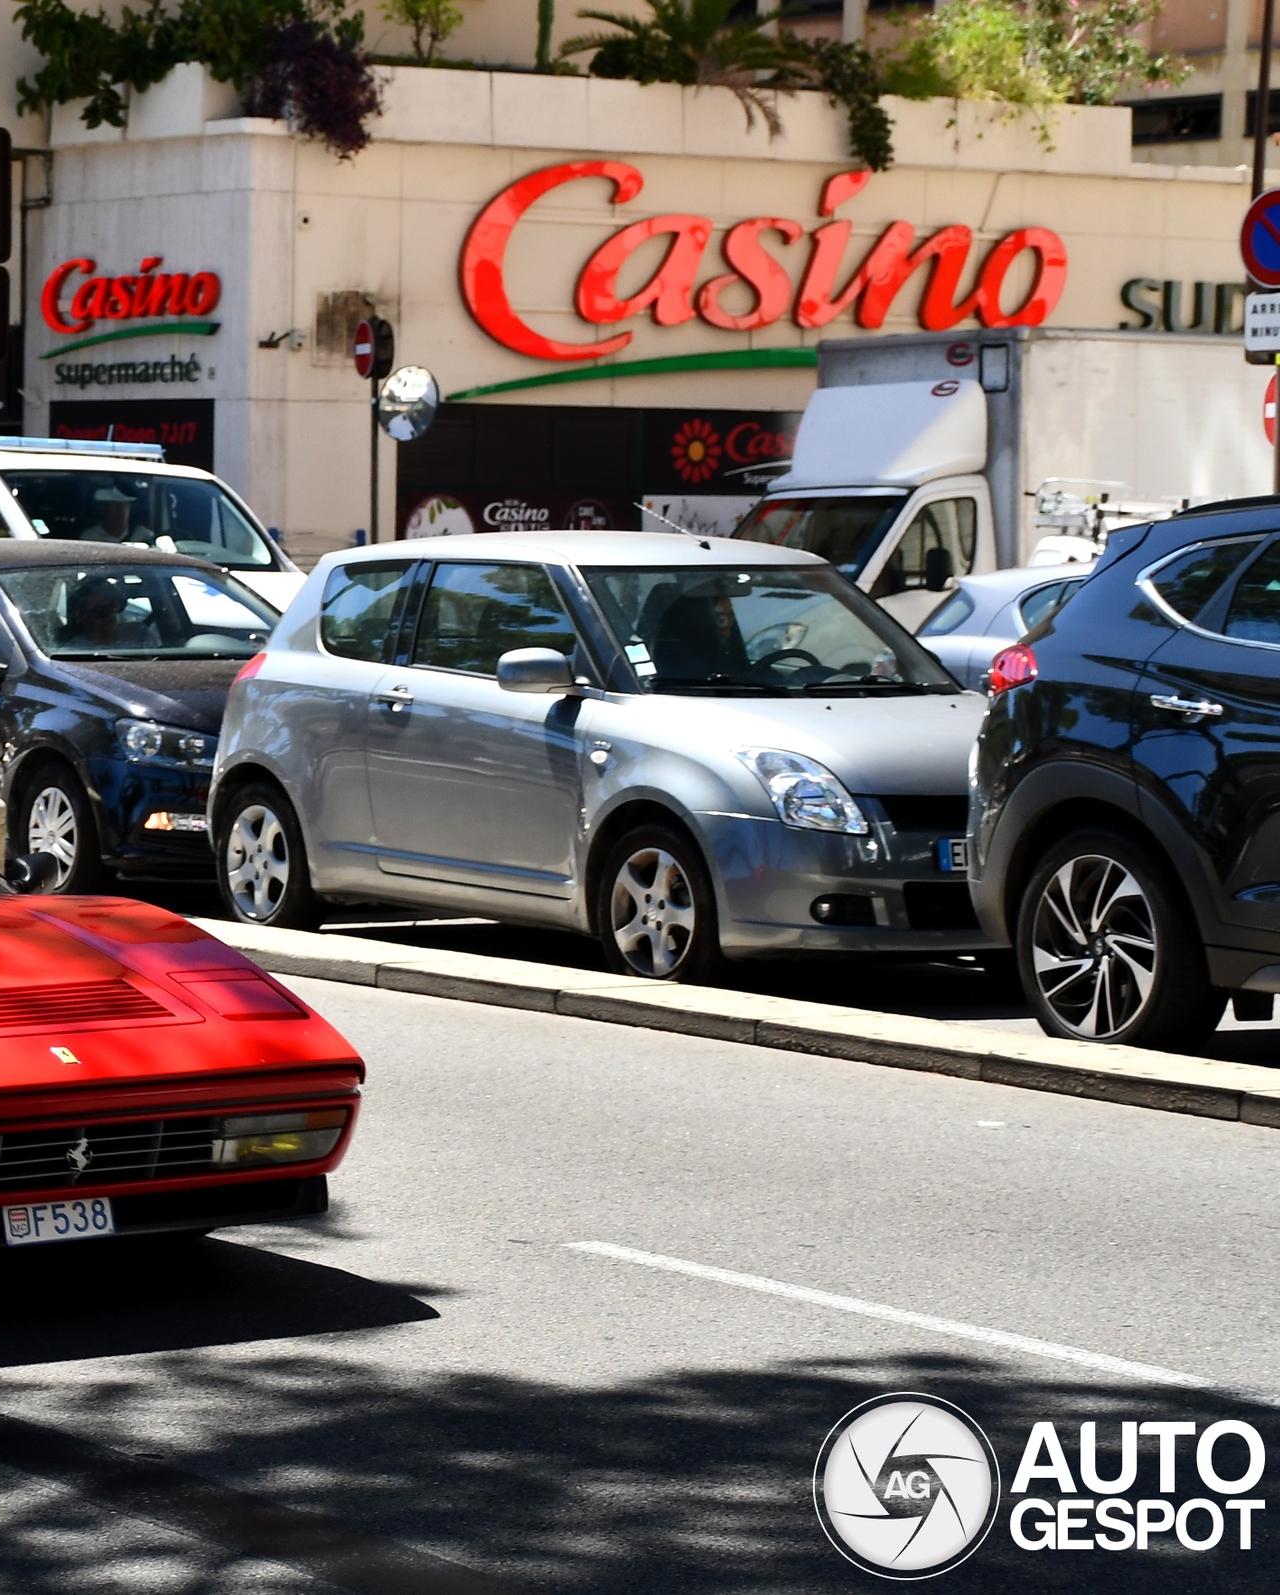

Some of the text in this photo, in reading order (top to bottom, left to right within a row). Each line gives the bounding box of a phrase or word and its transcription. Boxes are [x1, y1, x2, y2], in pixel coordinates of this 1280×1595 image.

[459, 160, 1068, 361] Casino
[40, 256, 222, 335] Casino
[1251, 303, 1280, 315] ARR
[55, 352, 201, 390] supermarché
[483, 501, 549, 526] Casino
[32, 1199, 108, 1237] F538
